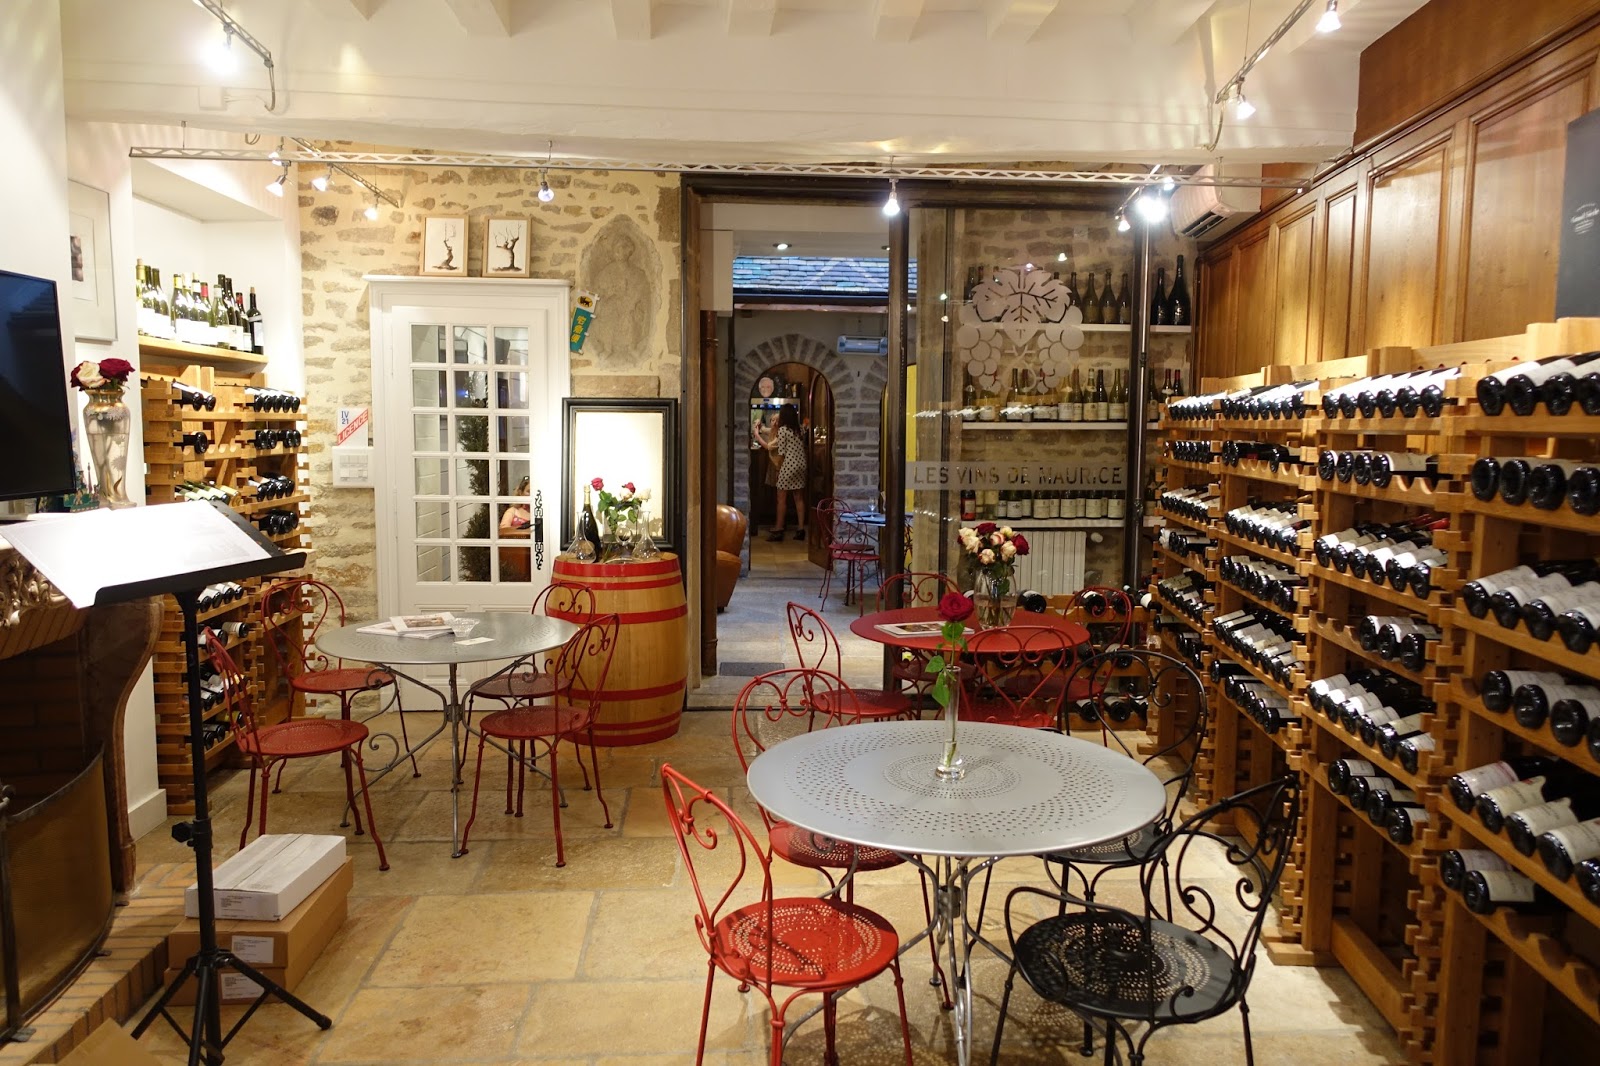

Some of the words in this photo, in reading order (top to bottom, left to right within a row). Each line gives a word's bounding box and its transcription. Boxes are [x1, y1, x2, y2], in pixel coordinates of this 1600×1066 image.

[341, 410, 350, 419] IV
[338, 410, 368, 443] LICENCE
[914, 466, 949, 484] LES
[955, 466, 1000, 484] VINS
[1007, 466, 1031, 484] DE
[1039, 466, 1122, 484] MAURICE
